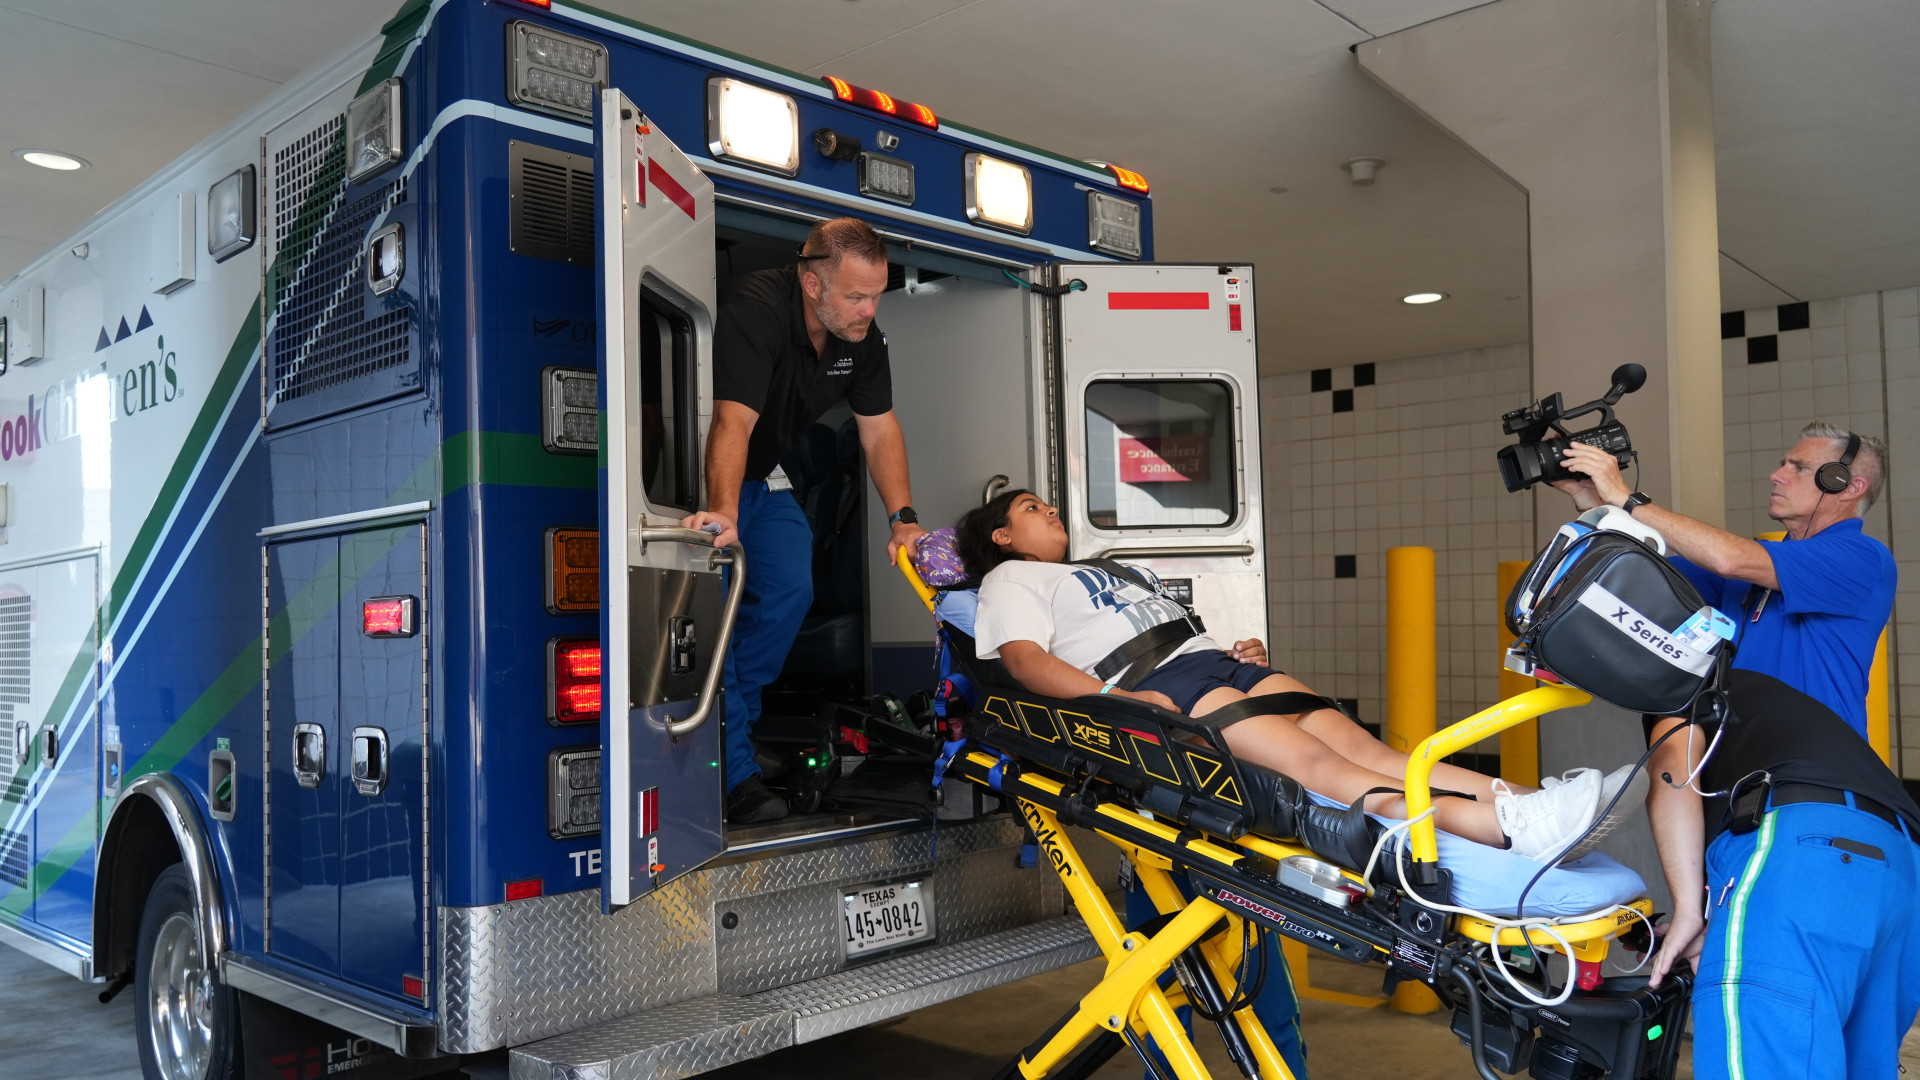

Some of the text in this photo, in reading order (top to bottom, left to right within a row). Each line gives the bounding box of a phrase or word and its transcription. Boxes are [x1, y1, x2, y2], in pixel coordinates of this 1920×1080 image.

[0, 394, 42, 461] ook
[43, 334, 177, 445] Chren's
[1610, 606, 1629, 624] X
[1629, 618, 1683, 660] Series
[1073, 721, 1111, 746] XPS
[862, 887, 896, 905] TEXAS
[869, 900, 890, 908] EXEMPT
[1217, 888, 1335, 941] power pro XT
